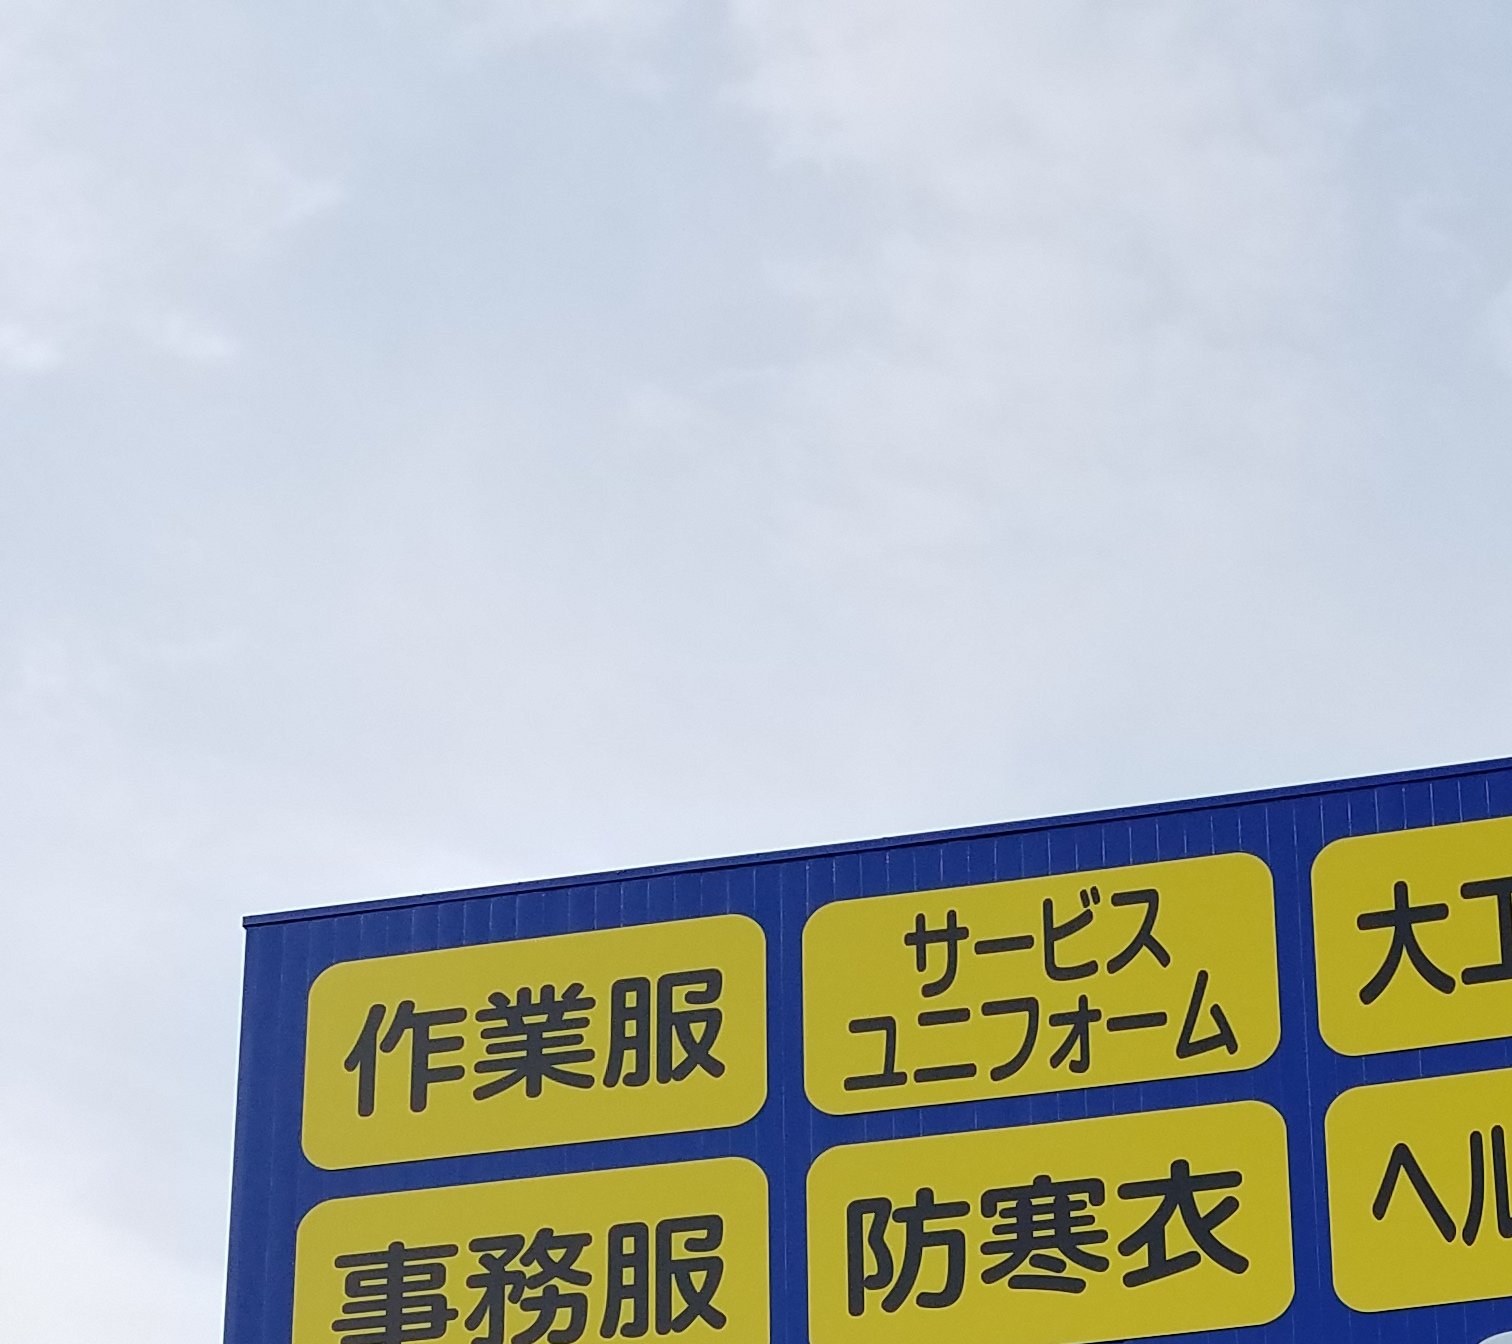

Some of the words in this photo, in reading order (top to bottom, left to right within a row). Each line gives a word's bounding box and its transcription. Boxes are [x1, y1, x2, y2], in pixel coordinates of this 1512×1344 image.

[904, 886, 1171, 998] サービス
[343, 967, 726, 1118] 作業服
[842, 970, 1240, 1092] ユニフォーム
[846, 1158, 1250, 1317] 防寒衣
